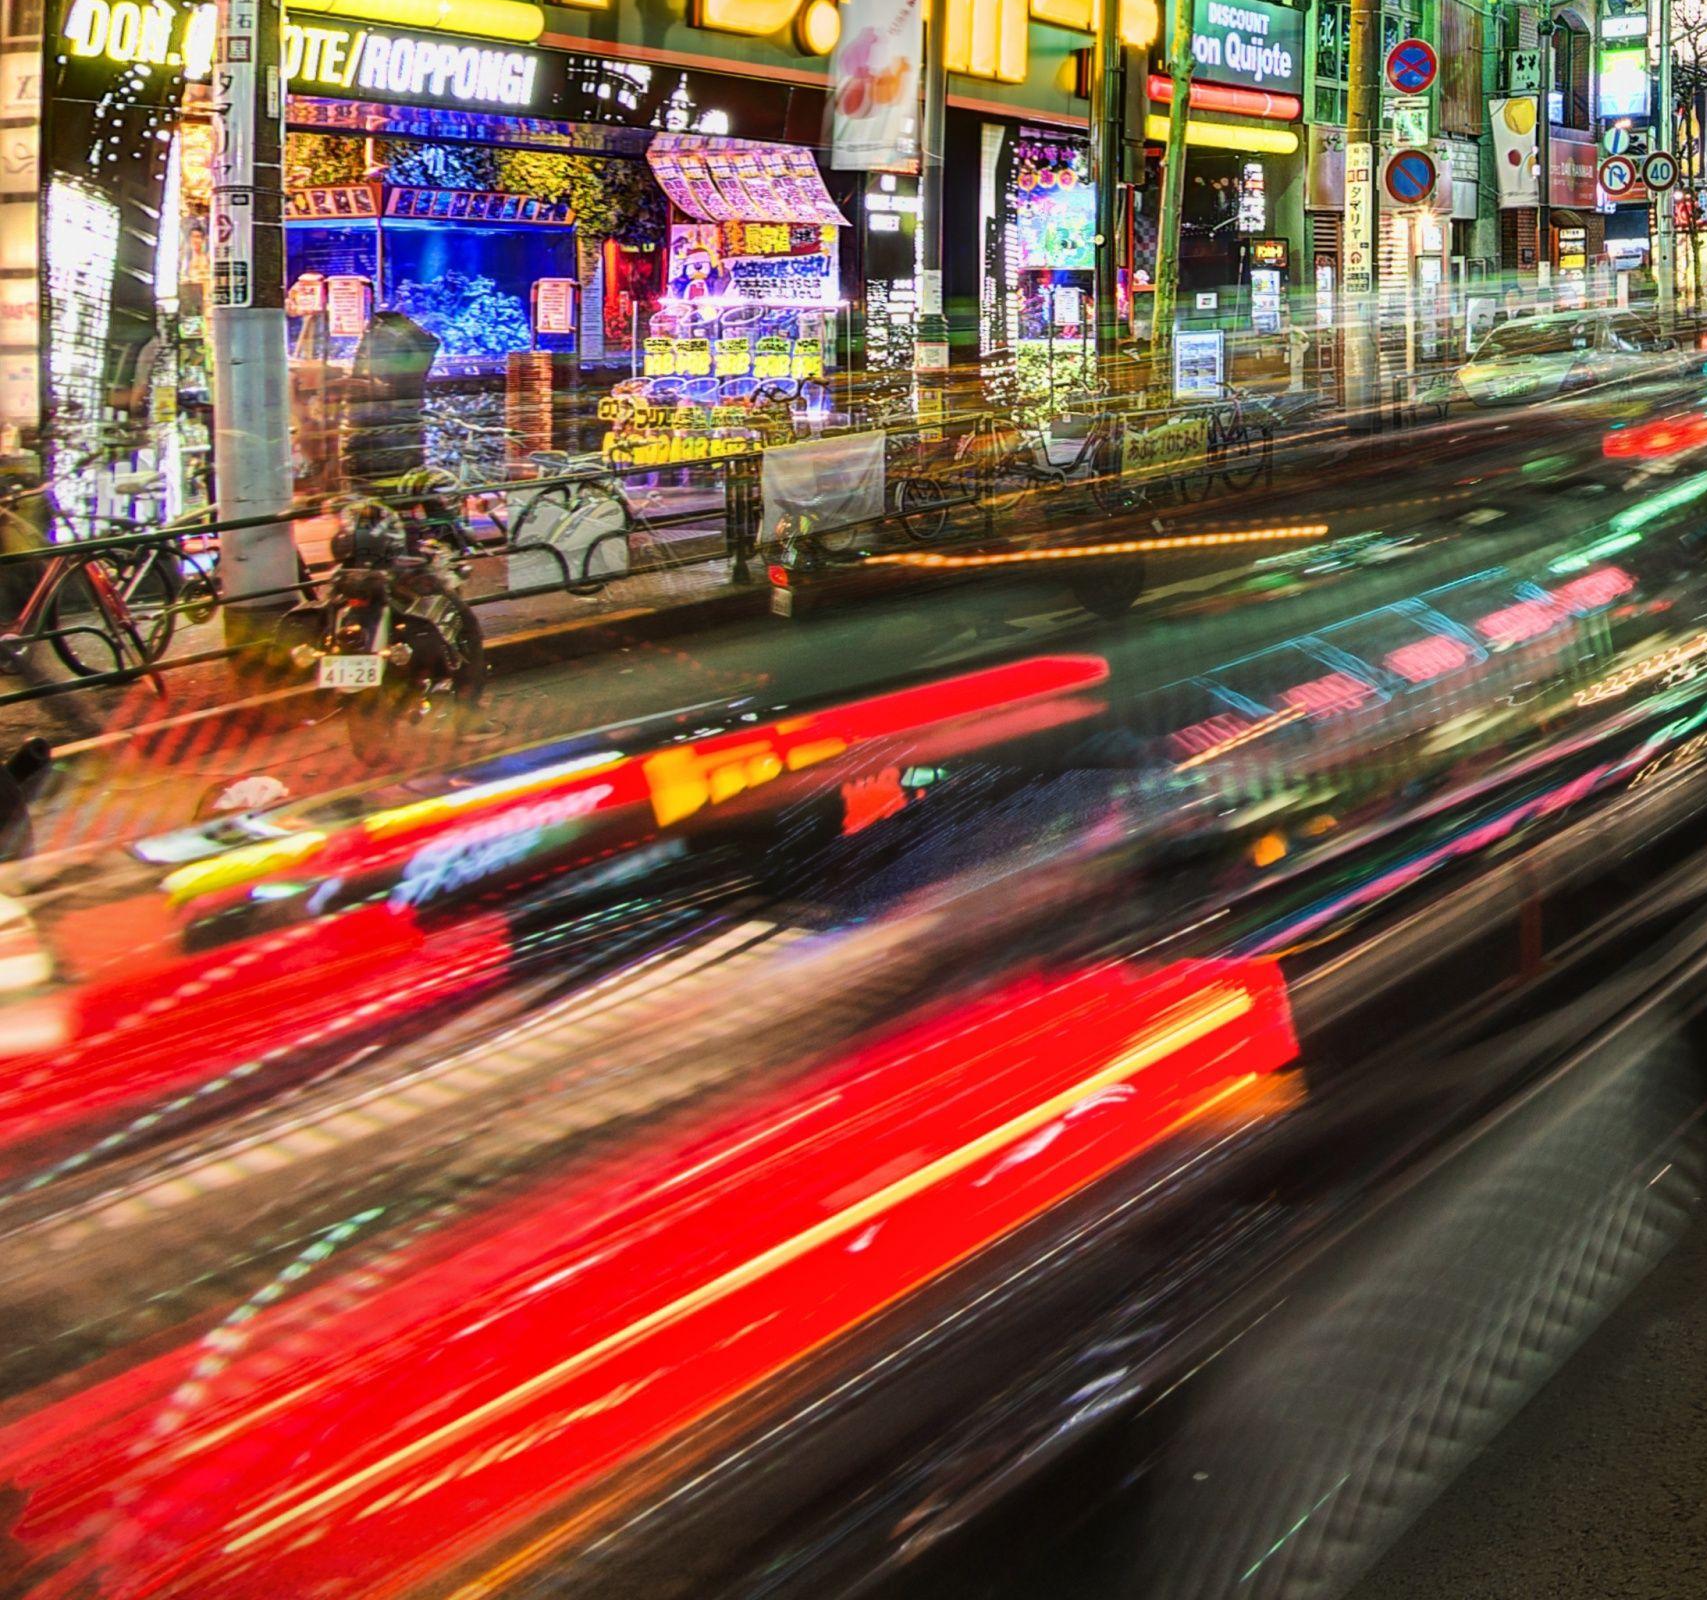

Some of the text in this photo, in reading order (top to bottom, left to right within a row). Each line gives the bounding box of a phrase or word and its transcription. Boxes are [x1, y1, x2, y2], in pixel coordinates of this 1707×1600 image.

[1208, 1, 1271, 36] DISCOUNT
[1191, 30, 1293, 82] on Quijote
[1650, 162, 1671, 182] 40
[1349, 185, 1362, 239] タマリヤ
